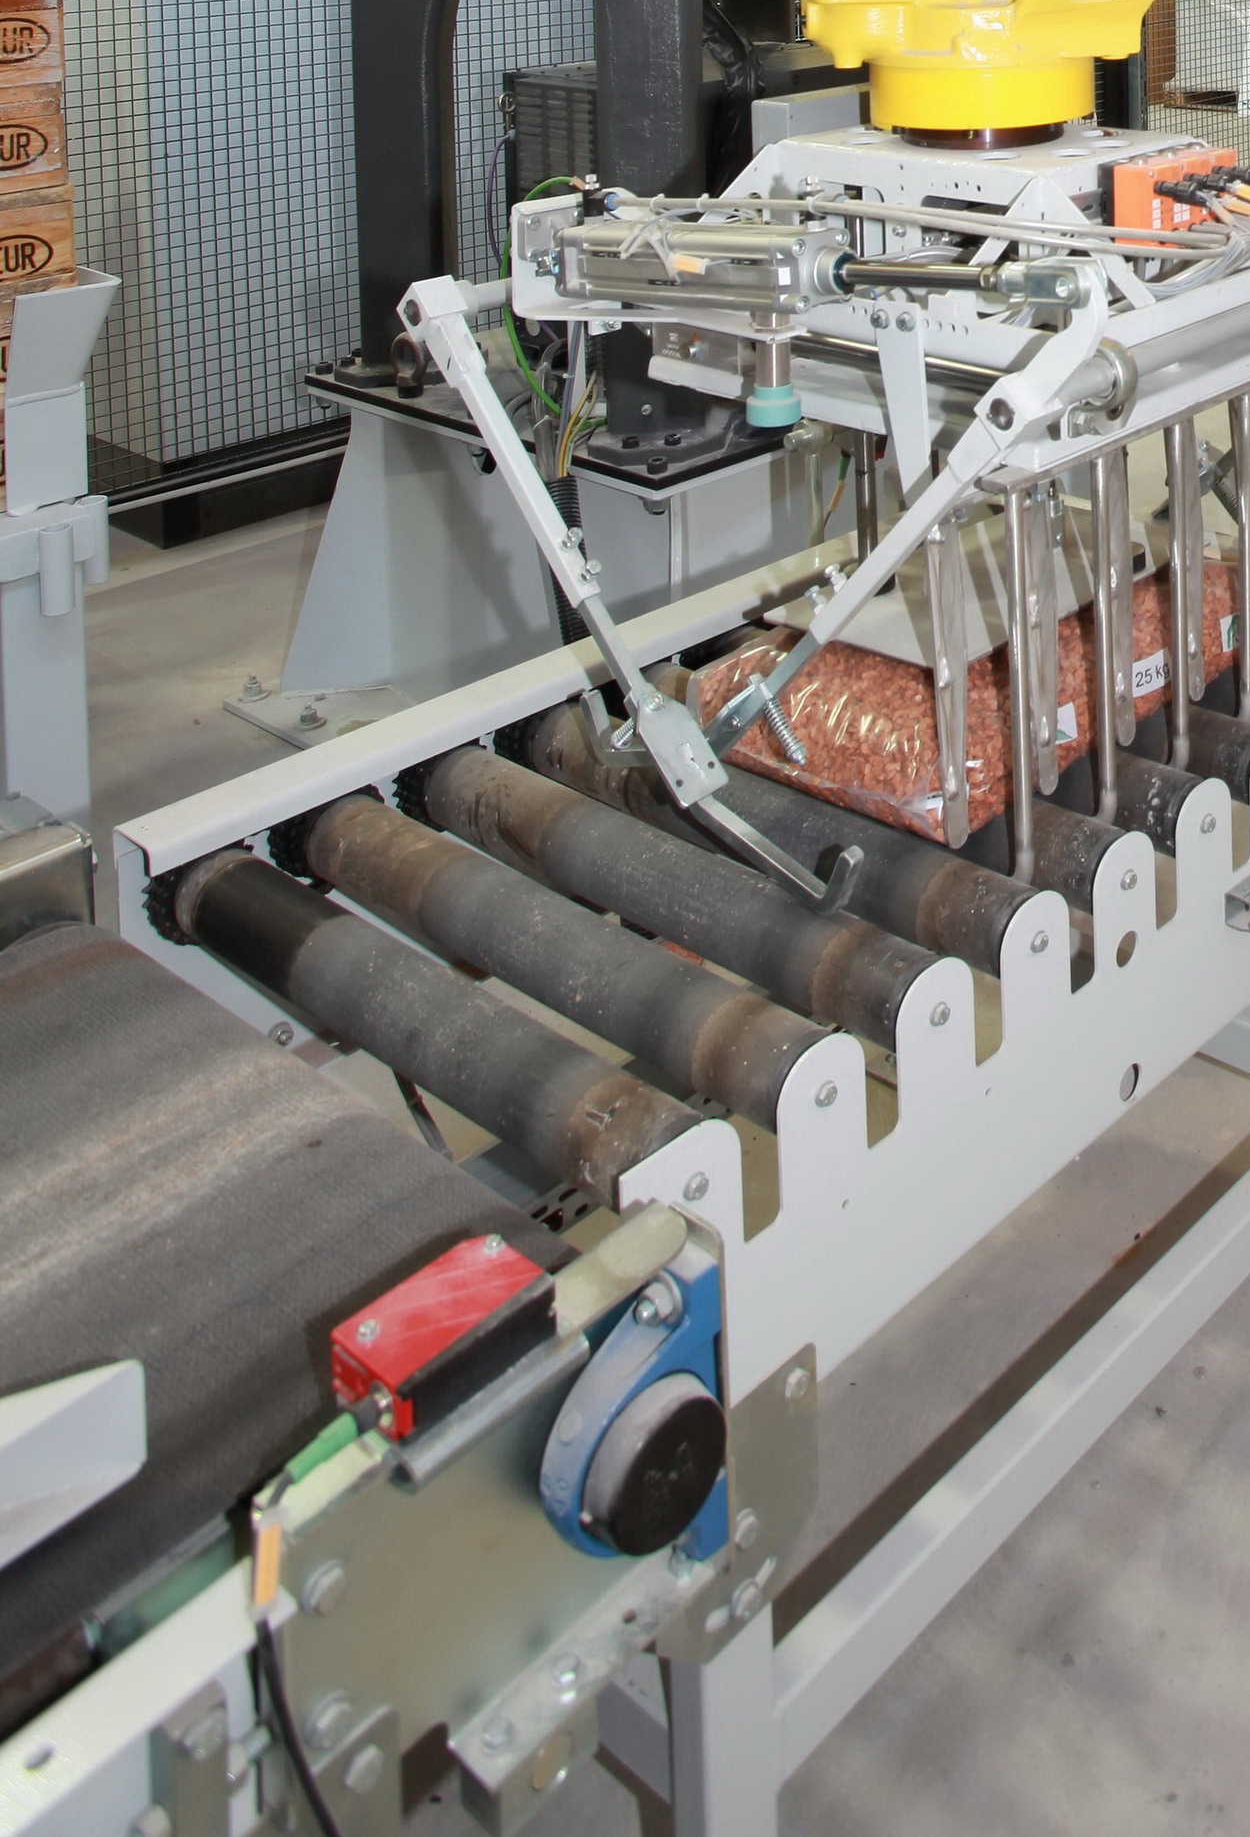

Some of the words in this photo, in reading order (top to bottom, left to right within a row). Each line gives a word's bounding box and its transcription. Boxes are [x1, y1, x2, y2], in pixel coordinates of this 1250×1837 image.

[0, 25, 34, 55] UR
[0, 132, 31, 162] UR
[0, 241, 37, 276] UR
[1135, 668, 1153, 688] 25
[1155, 663, 1171, 680] kg
